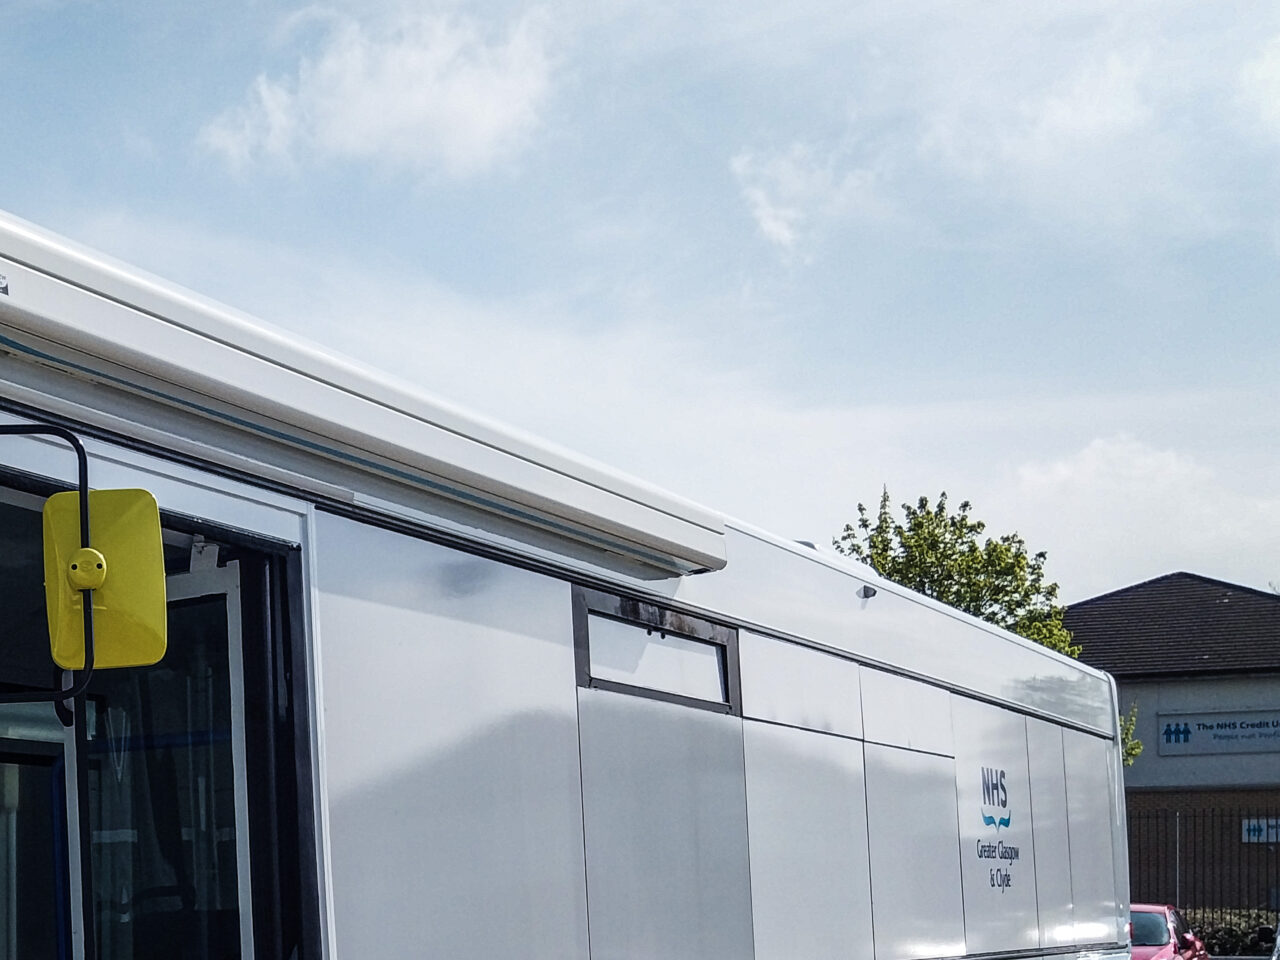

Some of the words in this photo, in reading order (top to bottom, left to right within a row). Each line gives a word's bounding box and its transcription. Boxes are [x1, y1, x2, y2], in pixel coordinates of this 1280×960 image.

[1196, 723, 1214, 731] The
[1216, 721, 1237, 730] NHS
[1239, 720, 1270, 729] Credit
[980, 766, 1008, 809] NHS
[976, 838, 997, 860] Greater
[997, 840, 1020, 866] Glasgow
[989, 868, 996, 888] &
[996, 867, 1012, 894] Clyde
